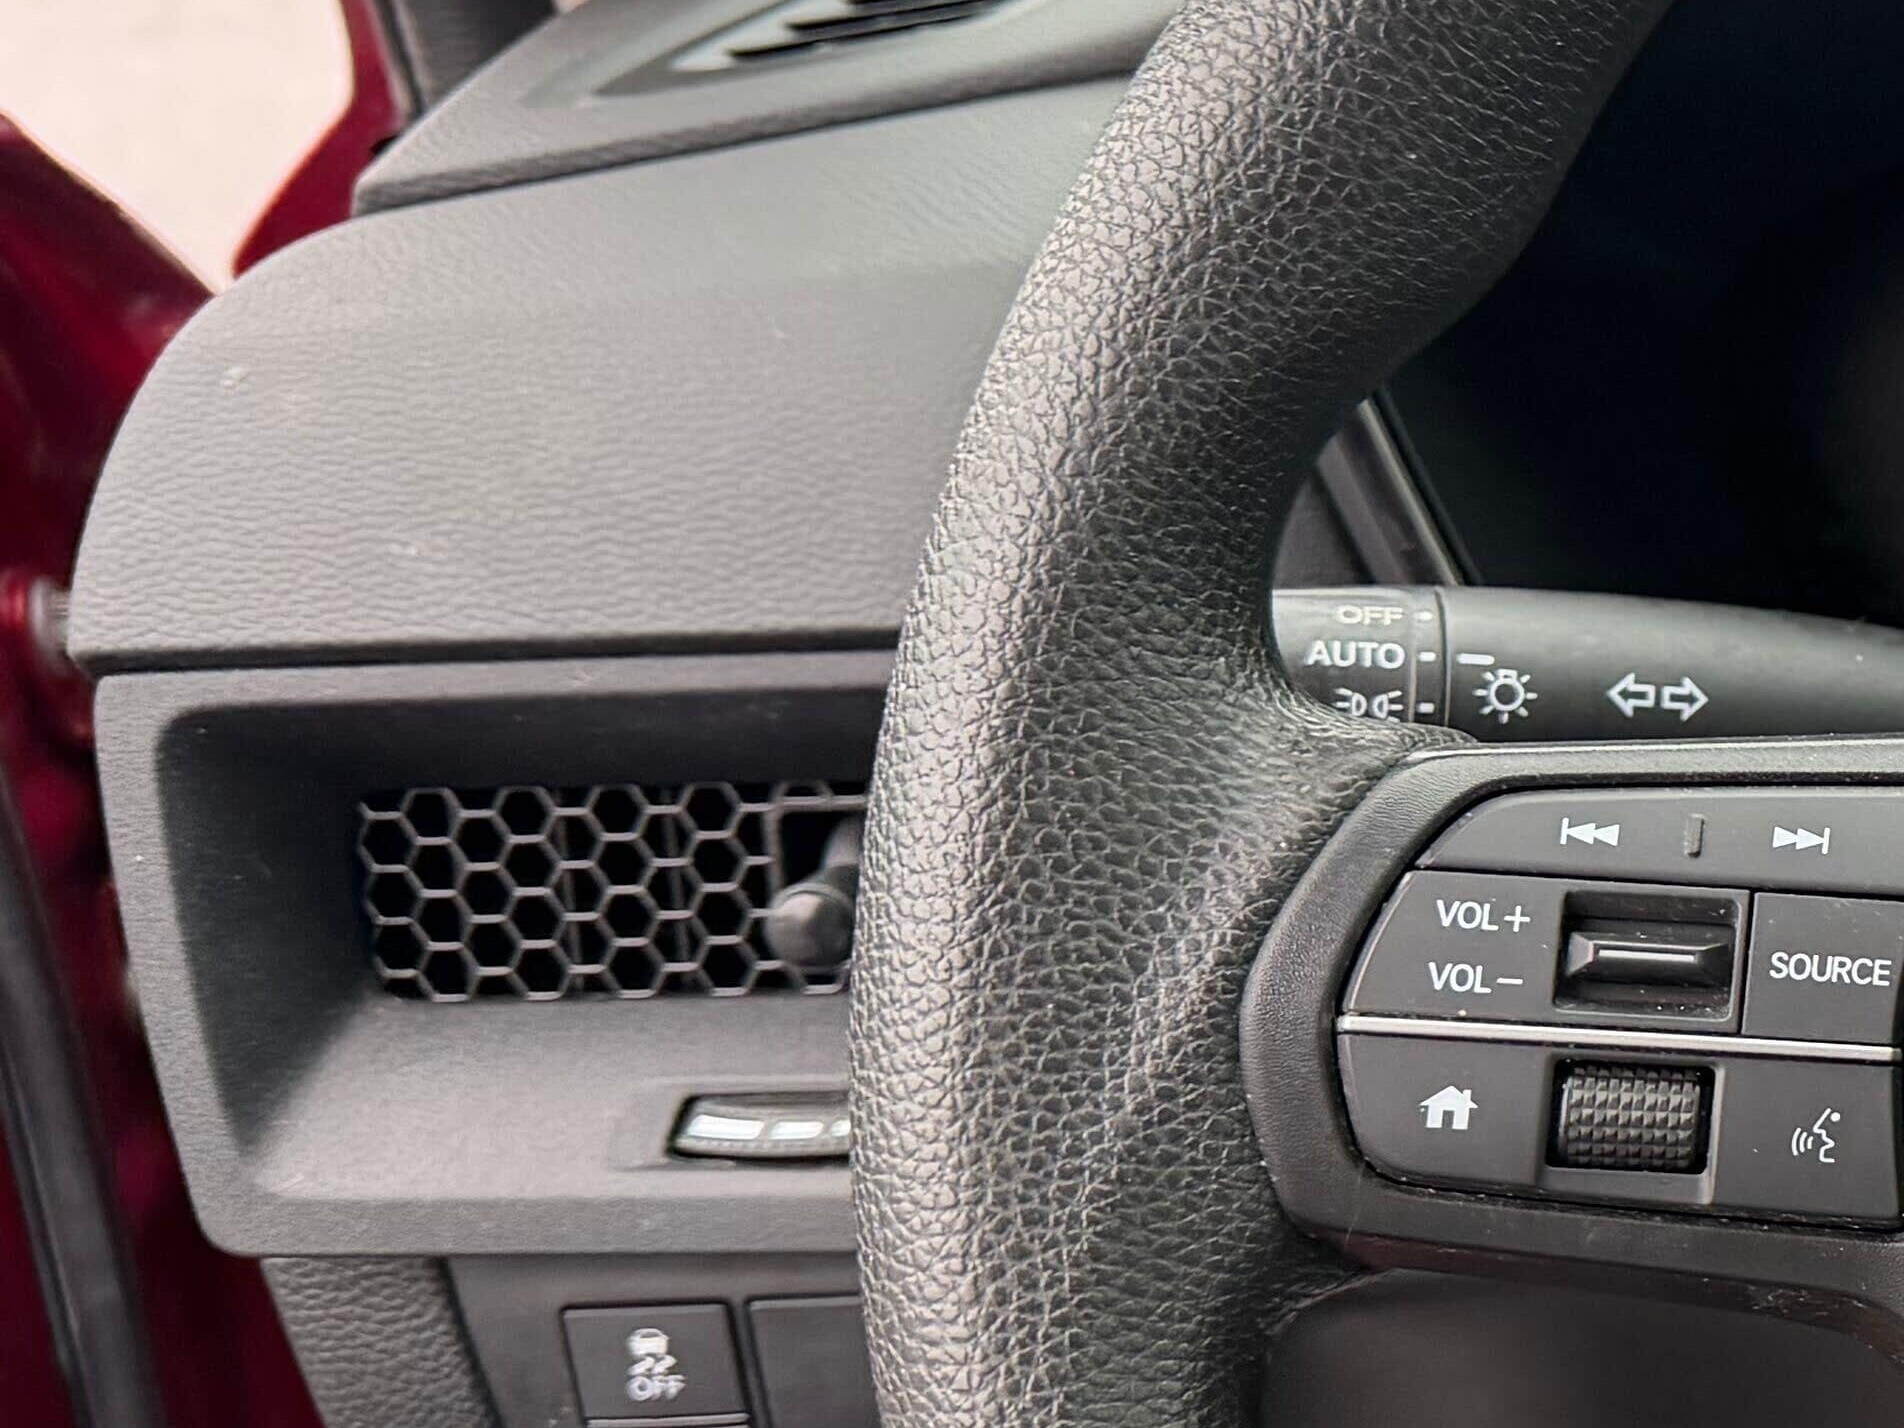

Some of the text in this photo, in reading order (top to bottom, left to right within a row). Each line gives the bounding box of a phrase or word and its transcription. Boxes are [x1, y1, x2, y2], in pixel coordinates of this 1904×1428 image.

[1335, 606, 1405, 626] OFF
[1305, 641, 1406, 670] AUTO
[1770, 952, 1892, 987] SOURCE
[626, 1374, 687, 1402] OFF
